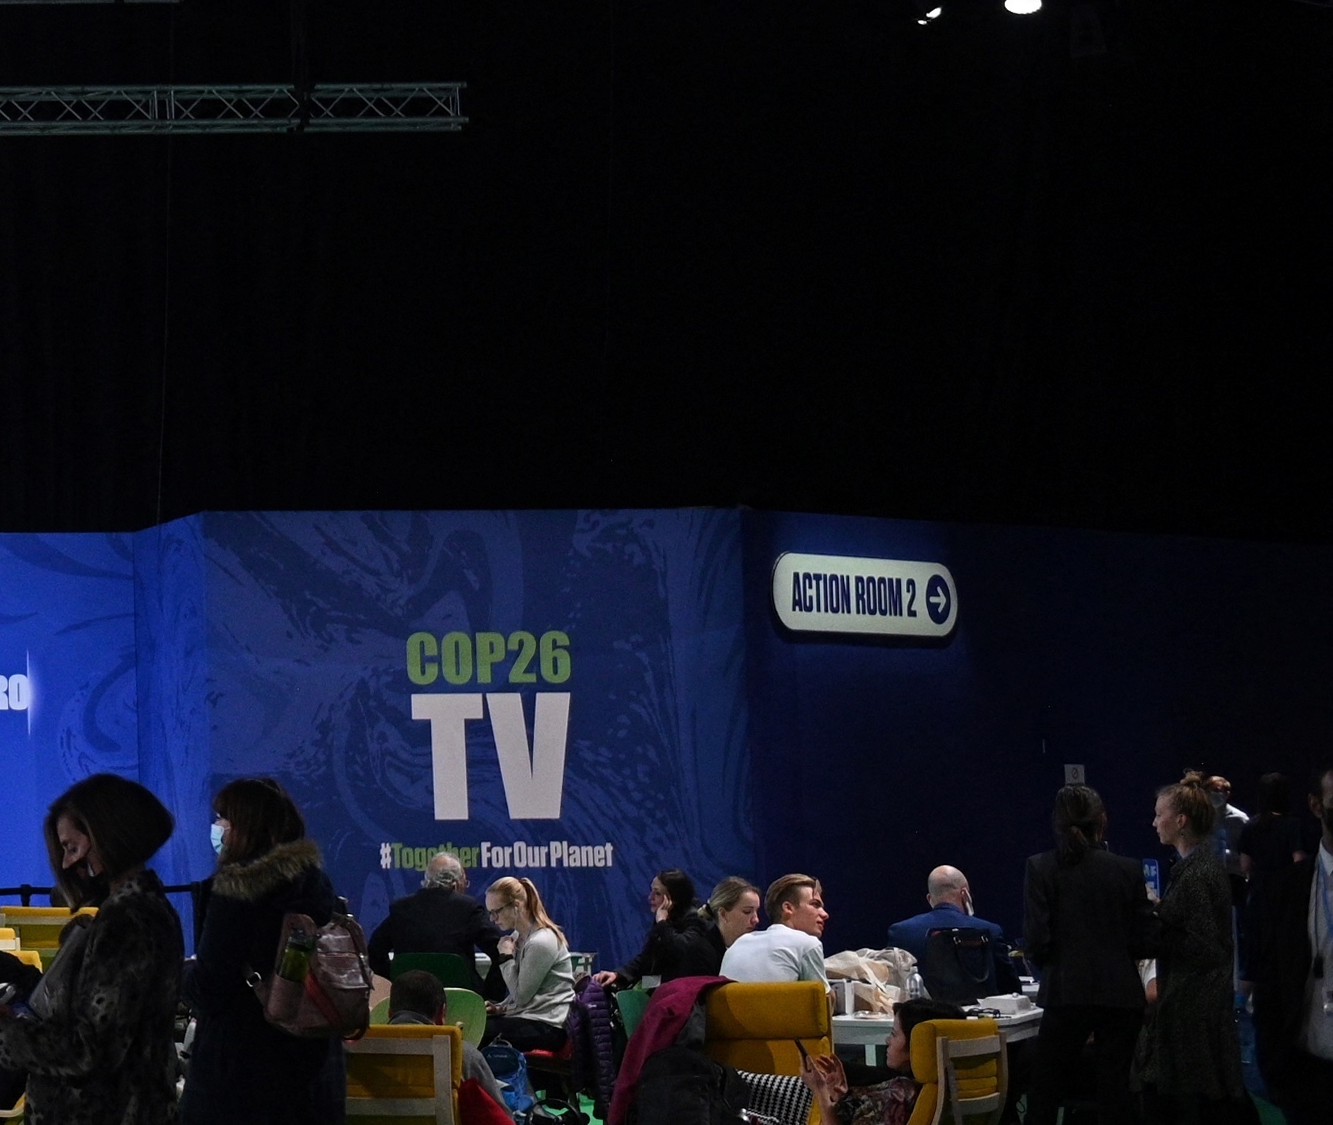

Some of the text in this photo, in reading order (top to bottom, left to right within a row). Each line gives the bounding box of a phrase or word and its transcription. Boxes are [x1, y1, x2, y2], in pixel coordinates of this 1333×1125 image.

[791, 571, 918, 618] ACTION ROOM 2
[406, 630, 572, 685] COP26
[411, 692, 571, 820] TV
